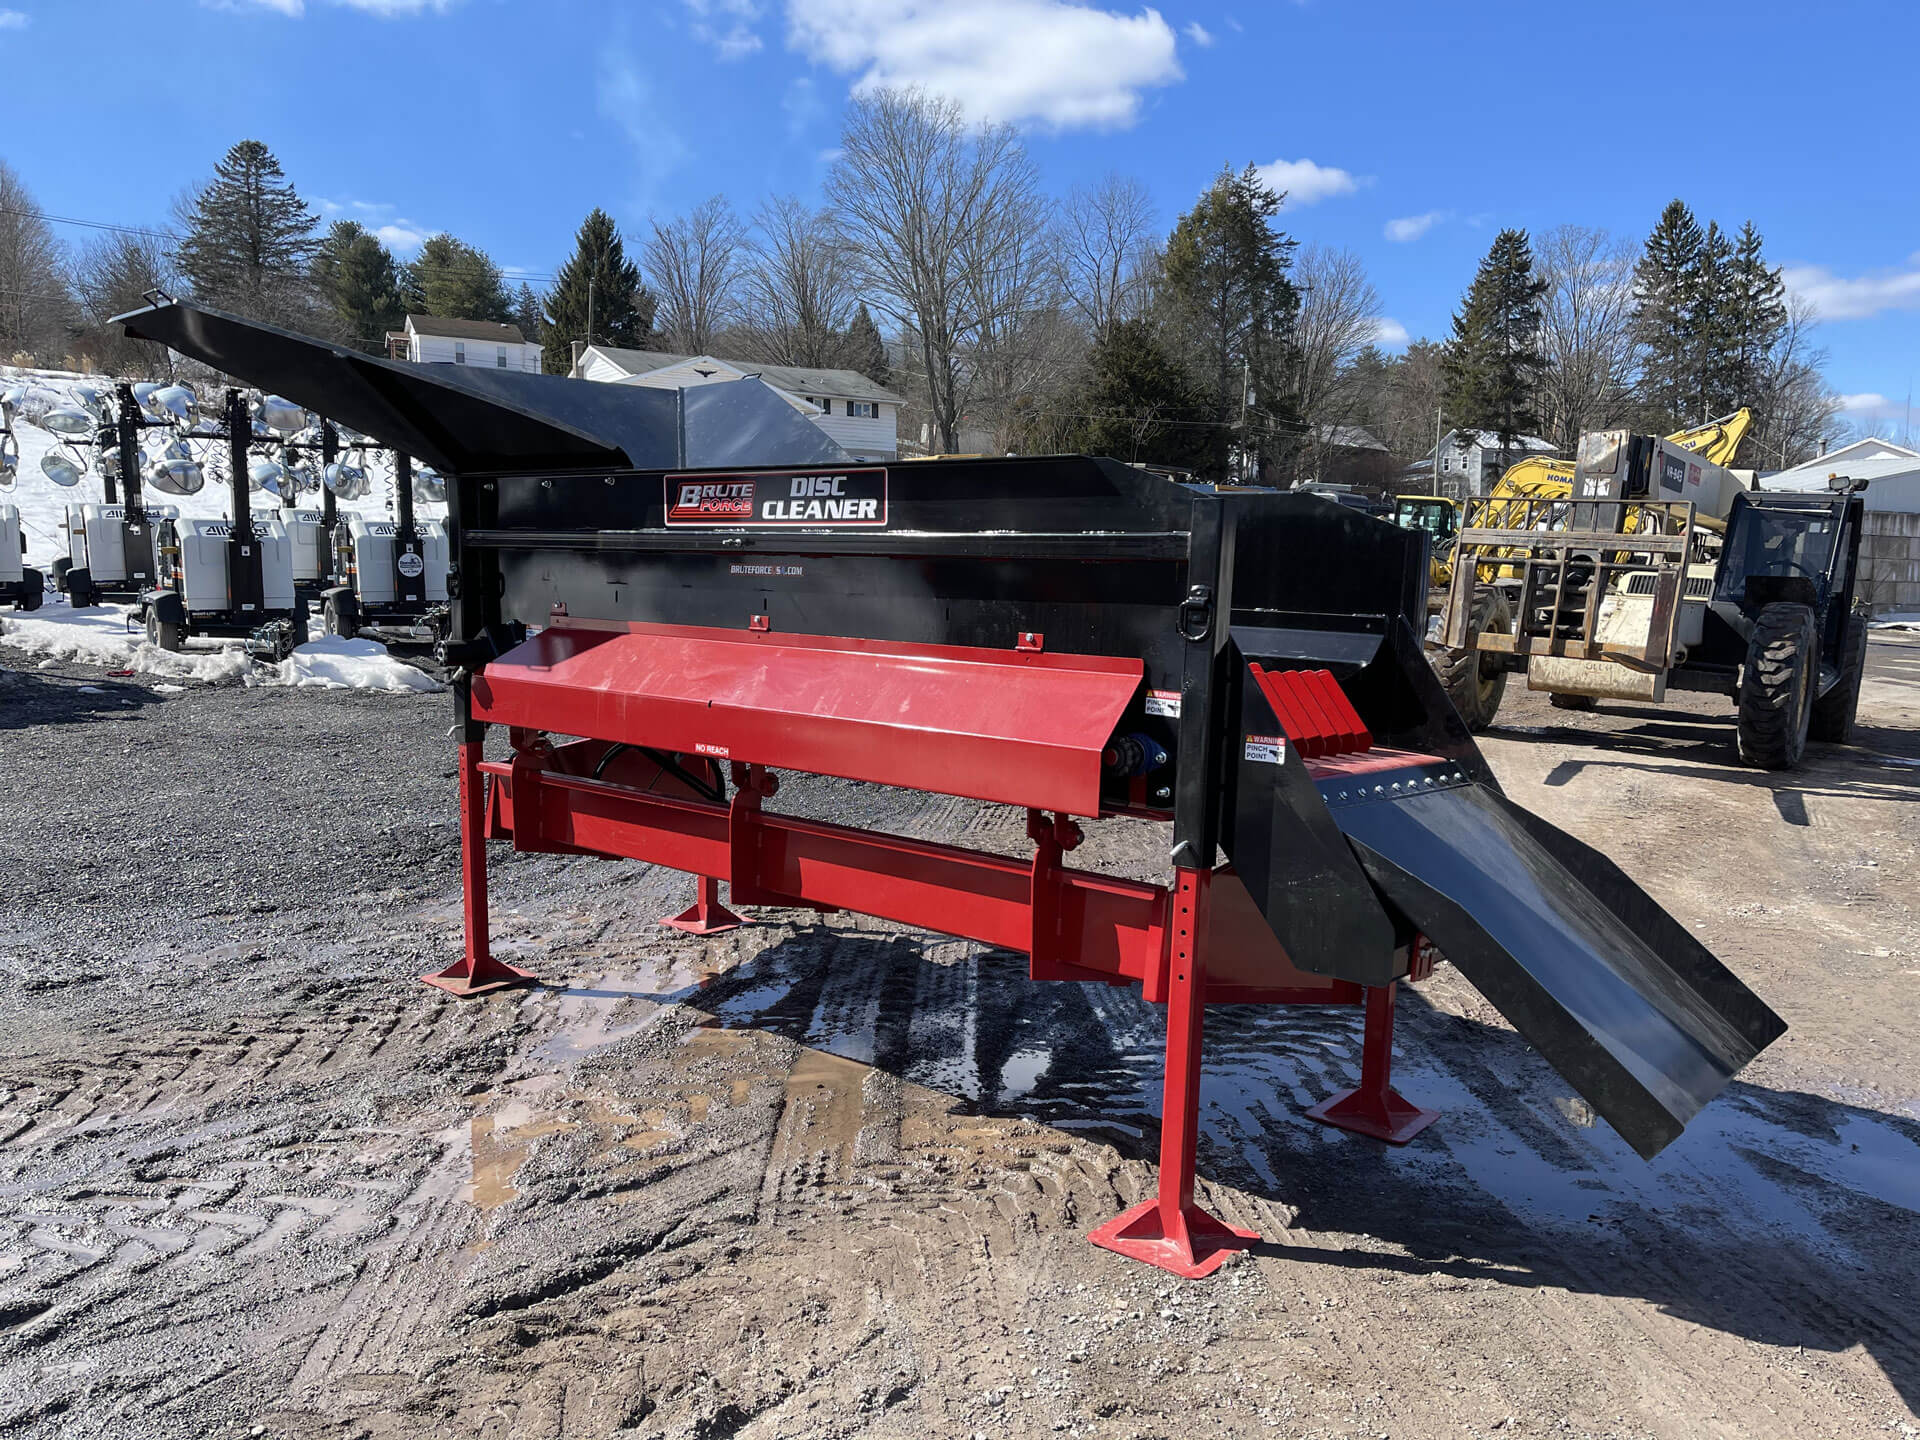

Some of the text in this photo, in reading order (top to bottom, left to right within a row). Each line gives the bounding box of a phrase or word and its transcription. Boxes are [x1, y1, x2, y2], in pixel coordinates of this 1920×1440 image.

[1547, 474, 1573, 484] KOMA
[790, 476, 848, 497] DISC
[679, 484, 754, 508] BRUTE
[700, 498, 752, 512] FORCE
[762, 498, 878, 520] CLEANER
[730, 565, 803, 576] BRUTEFORCES.COM
[695, 743, 729, 755] NO REACH
[1247, 744, 1268, 752] PINCH
[1246, 752, 1267, 760] POINT
